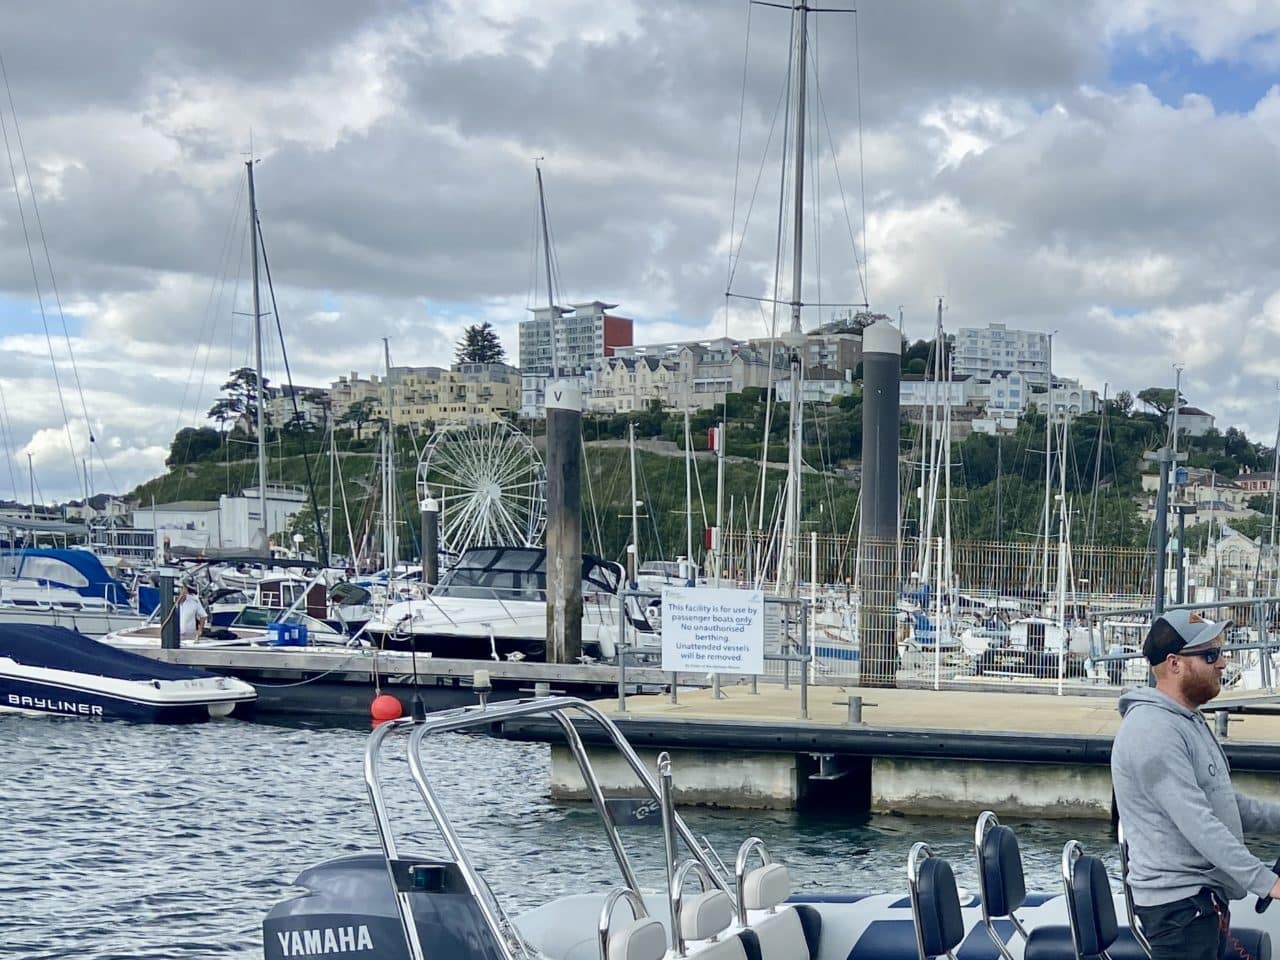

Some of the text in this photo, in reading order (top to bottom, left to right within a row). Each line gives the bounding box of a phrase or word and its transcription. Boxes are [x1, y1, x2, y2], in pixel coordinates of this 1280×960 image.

[668, 603, 684, 611] This
[685, 605, 711, 613] facility
[720, 605, 731, 613] for
[748, 606, 757, 615] by
[672, 615, 752, 625] passenger boats only
[681, 623, 745, 632] No unauthorised
[676, 643, 721, 651] Unattended
[8, 694, 103, 715] BAYLINER
[277, 924, 374, 957] YAMAHA
